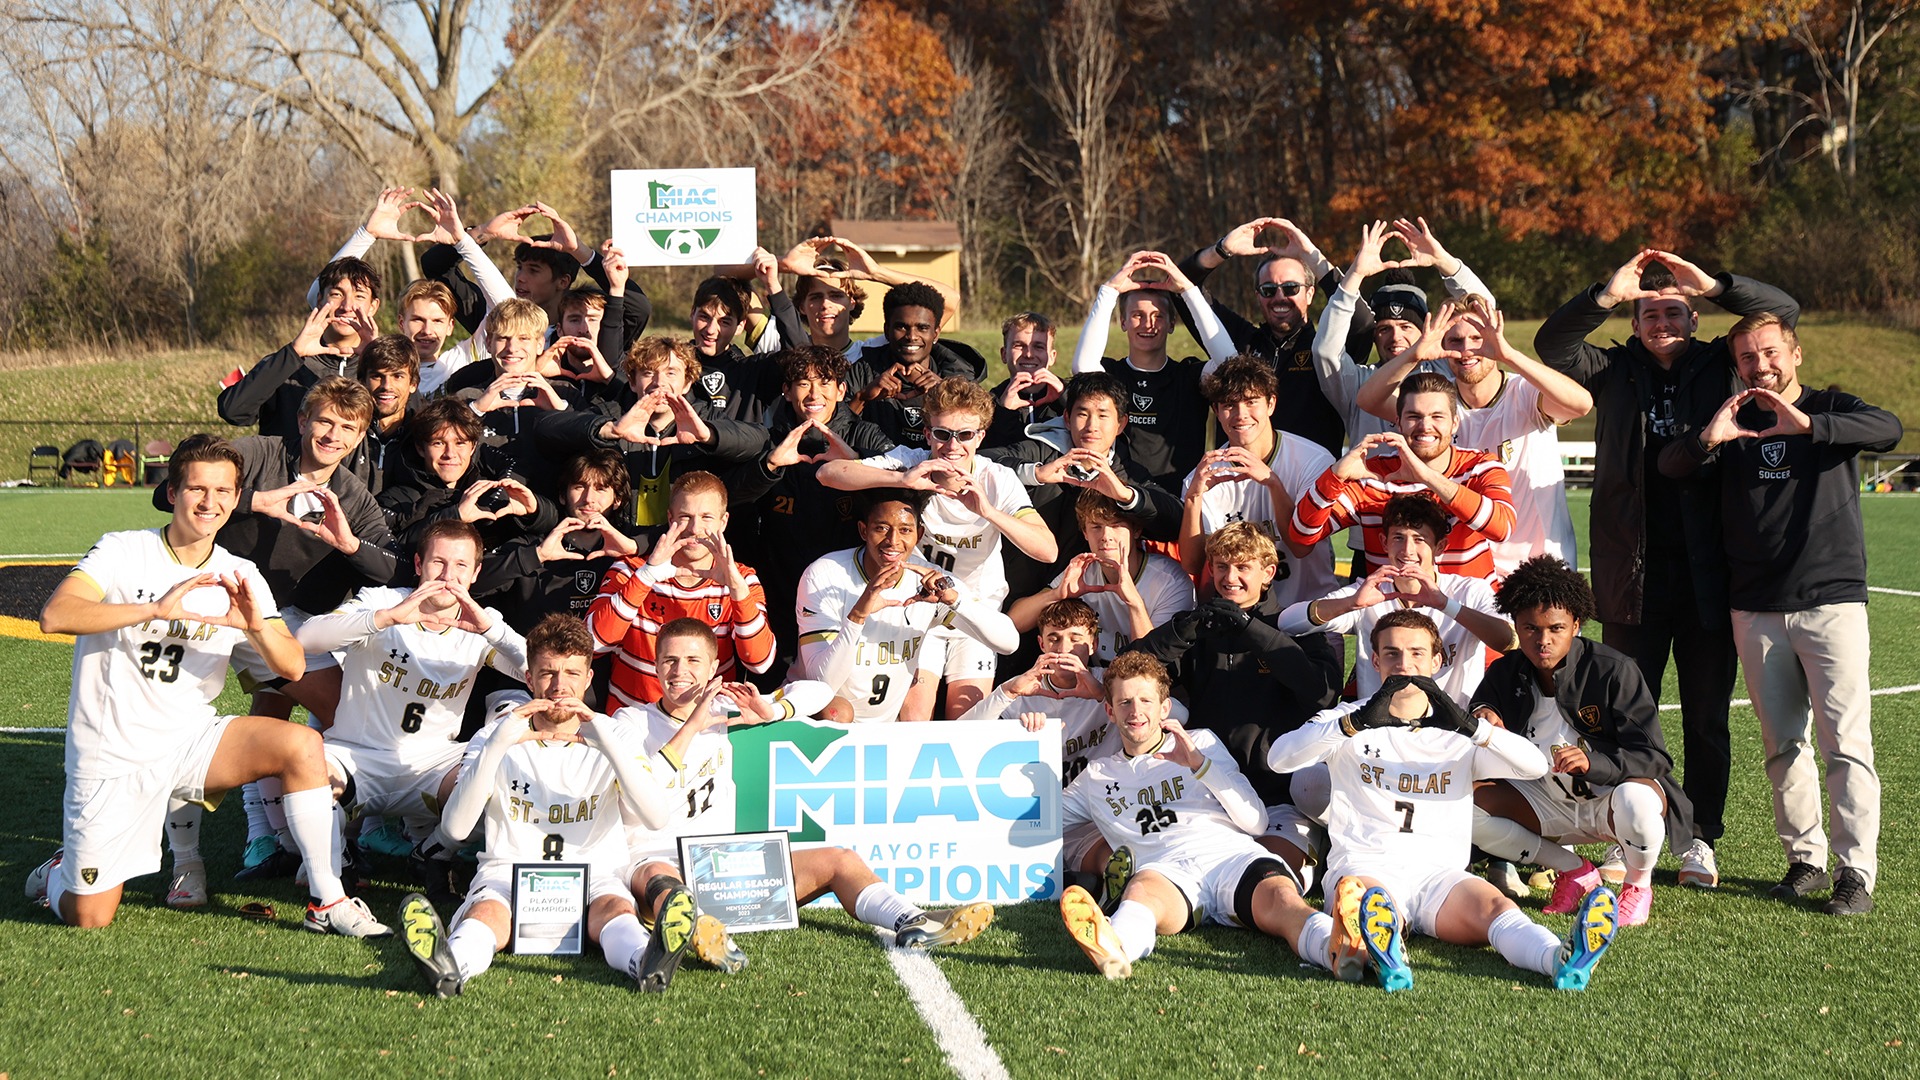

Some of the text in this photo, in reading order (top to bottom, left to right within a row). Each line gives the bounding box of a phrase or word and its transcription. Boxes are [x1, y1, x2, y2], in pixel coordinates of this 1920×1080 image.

[658, 188, 716, 206] MIAC
[635, 211, 733, 224] CHAMPIONS
[1128, 415, 1157, 425] SOCCER
[1758, 470, 1791, 479] SOCCER
[773, 496, 795, 515] 21
[570, 599, 591, 609] SOCC
[855, 636, 921, 667] T. OLAF
[140, 640, 185, 683] 23
[379, 661, 469, 700] ST. OLAF
[868, 674, 891, 706] 9
[401, 702, 426, 734] 6
[1065, 723, 1108, 756] OLAF
[774, 740, 1041, 827] MIAC
[1360, 762, 1452, 794] ST. OLAF
[1105, 775, 1185, 817] ST. OLAF
[508, 795, 600, 824] ST. OLAF
[1394, 800, 1415, 833] 7
[1028, 820, 1042, 829] TM
[1135, 805, 1178, 837] 25
[834, 842, 958, 861] AYOFF
[535, 879, 570, 891] MIAC
[697, 877, 783, 893] REGULAR SEASON
[529, 897, 571, 905] PLAYOFF
[713, 889, 770, 901] CHAMPIONS
[522, 905, 577, 913] CHAMPIONS
[741, 903, 762, 911] SOCCER
